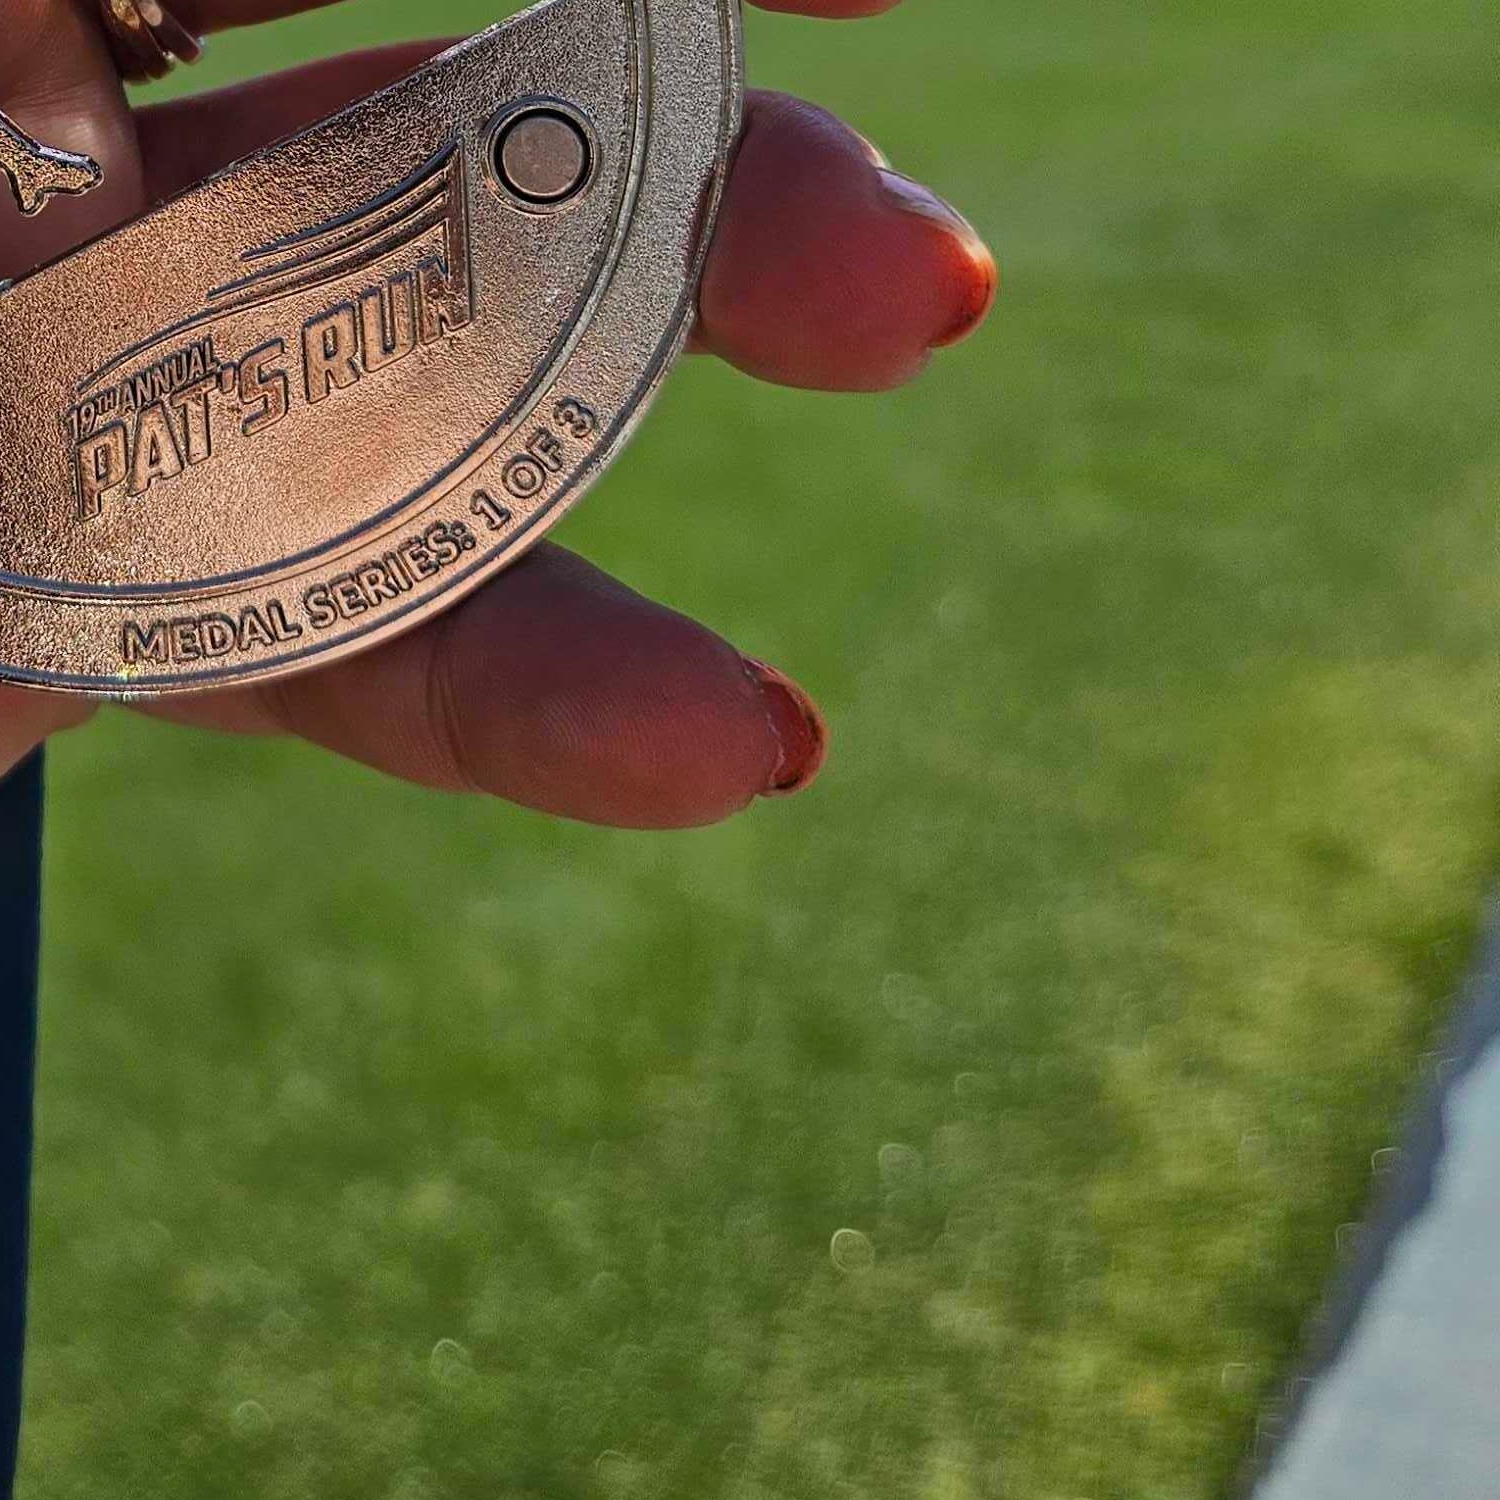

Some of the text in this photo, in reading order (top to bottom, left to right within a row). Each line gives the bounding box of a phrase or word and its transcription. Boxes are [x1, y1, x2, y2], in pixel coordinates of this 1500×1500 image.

[75, 252, 472, 521] PAT'S RUN
[119, 334, 221, 410] ANNUAL
[119, 394, 597, 663] MEDAL SERIES: 1 OF 3
